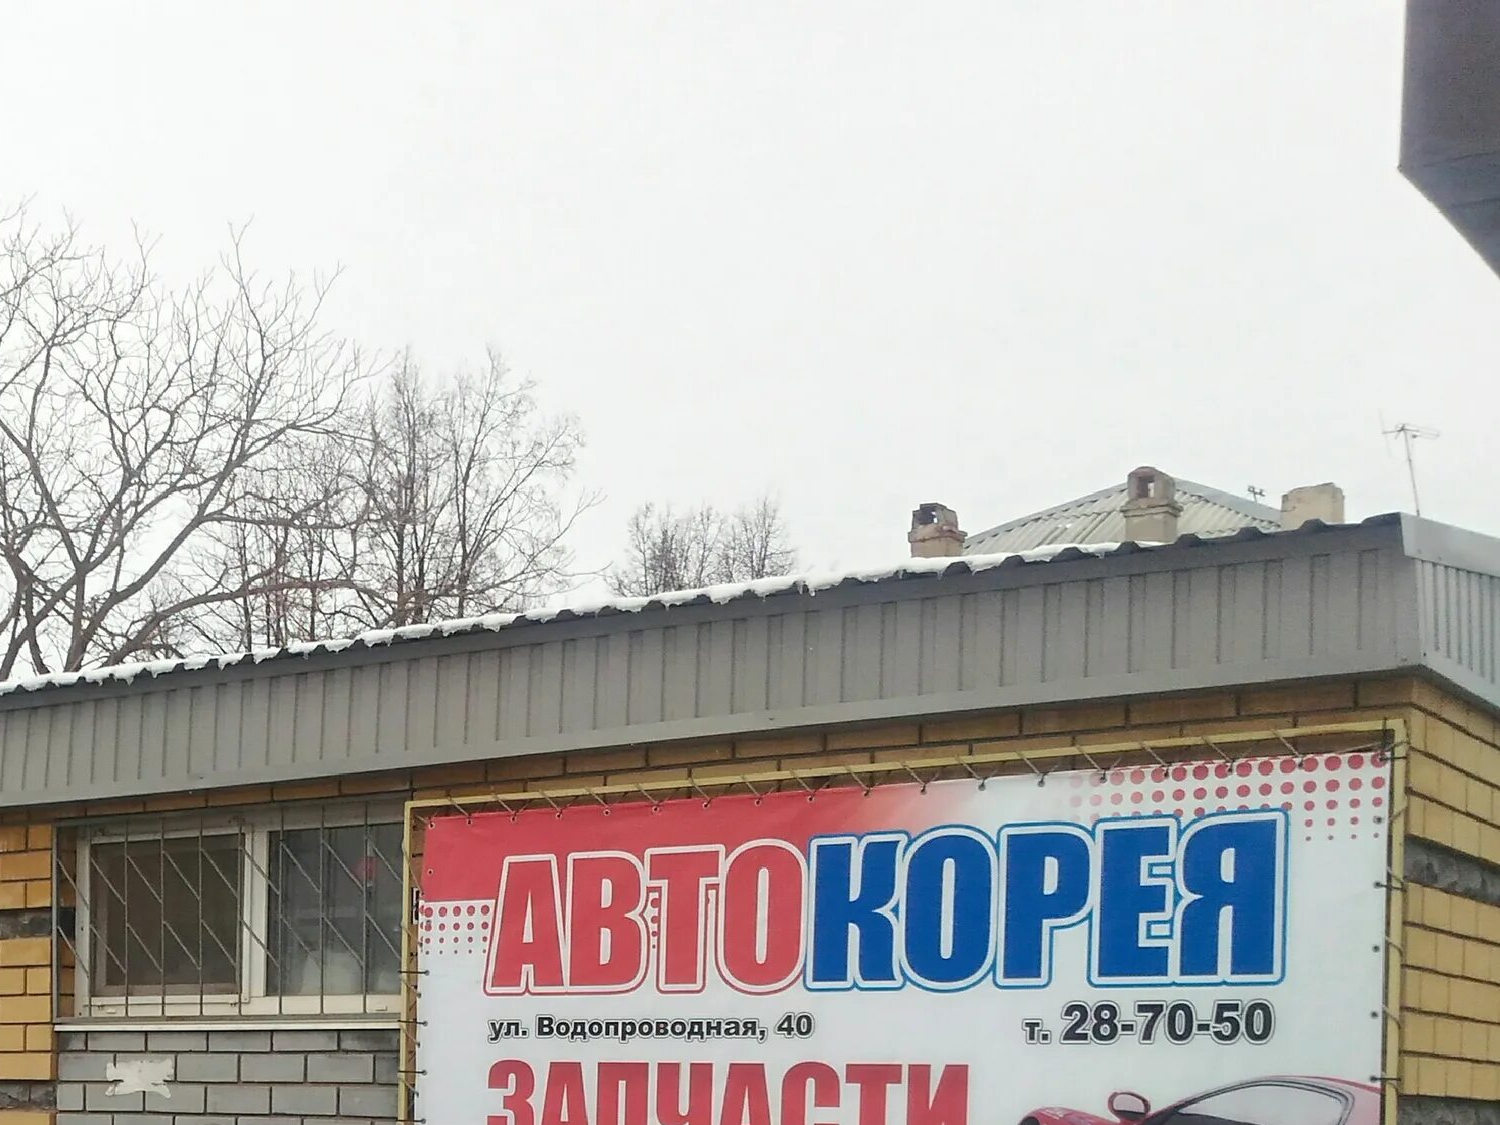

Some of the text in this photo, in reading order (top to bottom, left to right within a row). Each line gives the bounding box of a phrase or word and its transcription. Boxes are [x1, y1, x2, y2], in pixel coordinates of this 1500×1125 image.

[485, 810, 1287, 994] АВТОКОРЕЯ
[488, 1012, 816, 1043] ул. Водопроводная, 40
[1022, 998, 1276, 1046] т. 28-70-50
